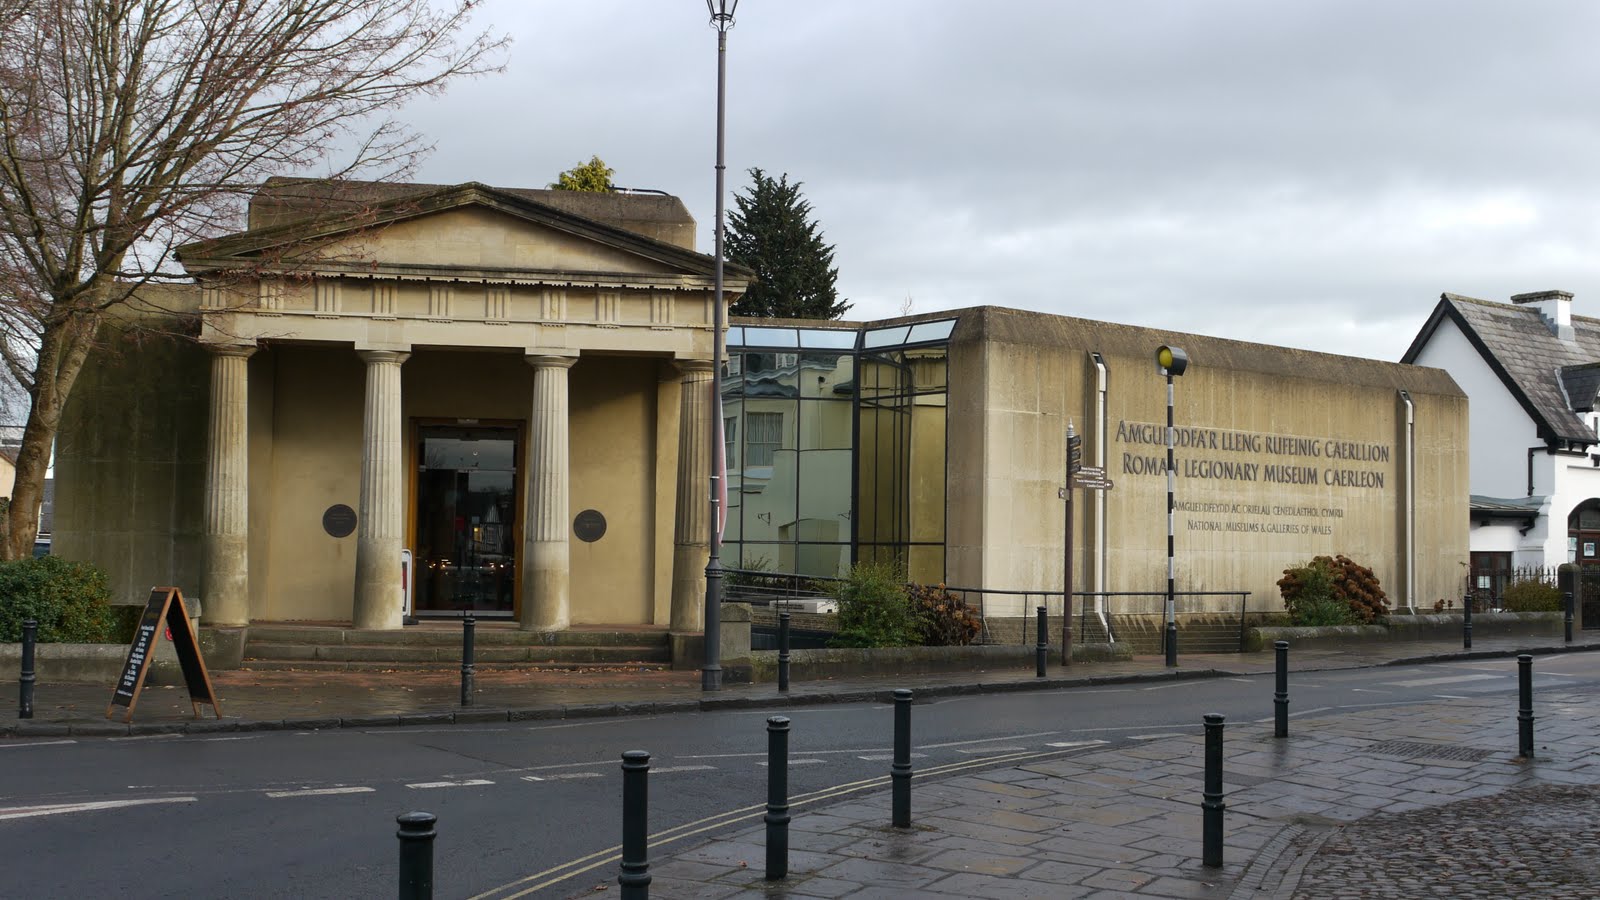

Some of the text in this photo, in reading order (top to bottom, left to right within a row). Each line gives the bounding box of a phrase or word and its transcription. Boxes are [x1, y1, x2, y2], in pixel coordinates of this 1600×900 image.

[1221, 432, 1261, 453] LLENG
[1265, 435, 1320, 458] RUFEINIG
[1325, 441, 1389, 463] CAERLLION
[1123, 452, 1384, 489] ROMAN LEGIONARY MUSEUM CAERLEON
[1173, 500, 1344, 518] AMGUEDDFEYDD AC ORIELAU CENEDLAETHOL CYMRU
[1187, 519, 1332, 536] NATIONAL MUSEUMS & GALLERIES OF WALES
